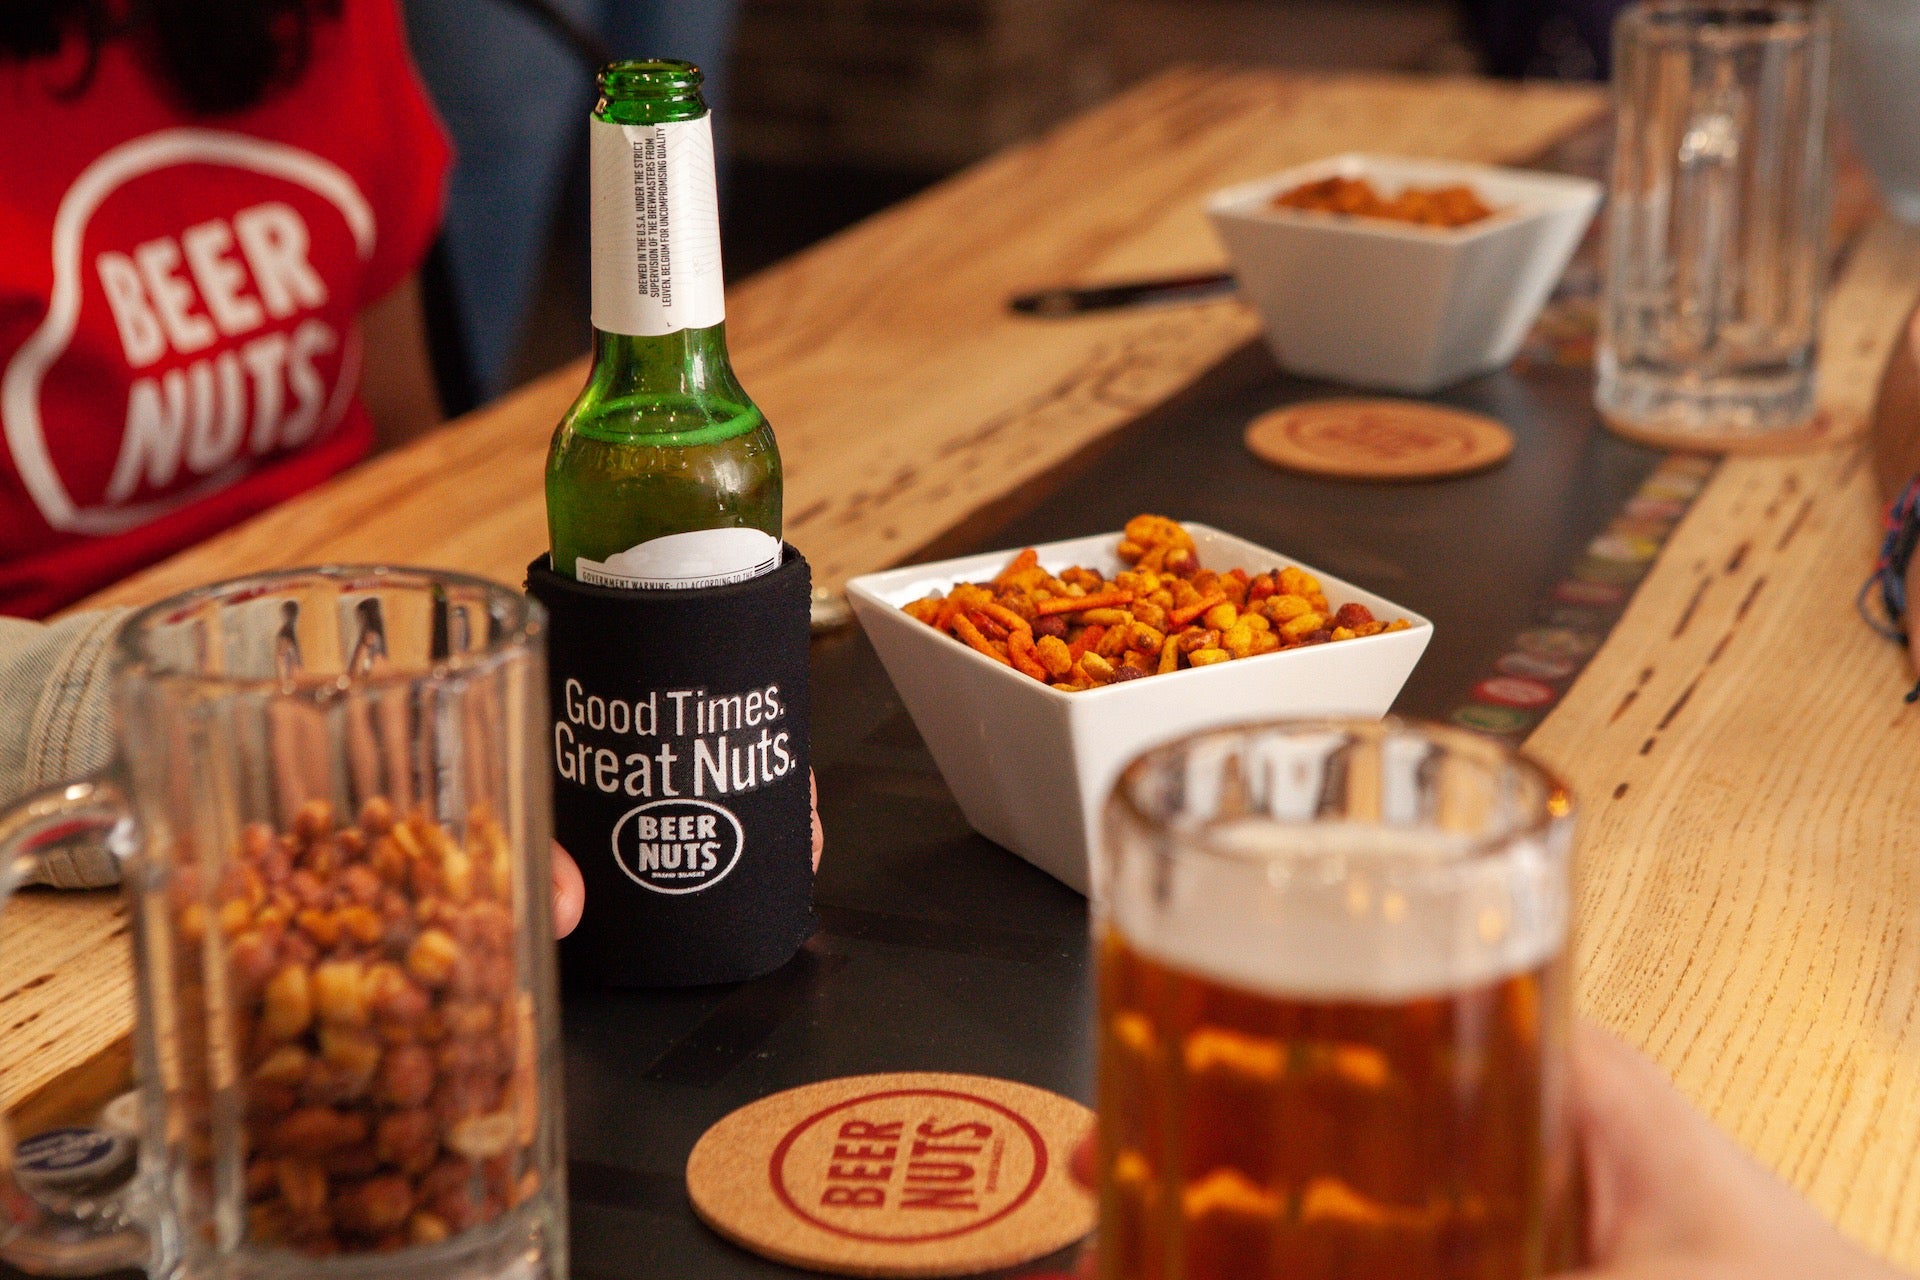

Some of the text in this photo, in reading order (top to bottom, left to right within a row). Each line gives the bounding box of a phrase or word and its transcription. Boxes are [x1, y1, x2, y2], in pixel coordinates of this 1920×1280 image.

[633, 141, 648, 295] BREWED IN THE U.S.A. UNDER THE STRICT
[645, 138, 660, 298] SUPERVISION OF THE BREWMASTERS FROM
[656, 127, 672, 307] LEUVEN, BELGIUM FOR UNCOMPROMISING QUALITY
[95, 200, 331, 370] BEER
[104, 317, 340, 505] NUTS
[582, 571, 630, 589] GOVERNMENT
[733, 574, 742, 584] TO
[743, 571, 753, 582] THE
[565, 678, 785, 737] Good Times.
[554, 720, 796, 797] Great Nuts.
[637, 815, 717, 841] BEER
[638, 842, 721, 872] NUTS
[820, 1120, 904, 1209] BEER
[899, 1117, 993, 1212] NUTS
